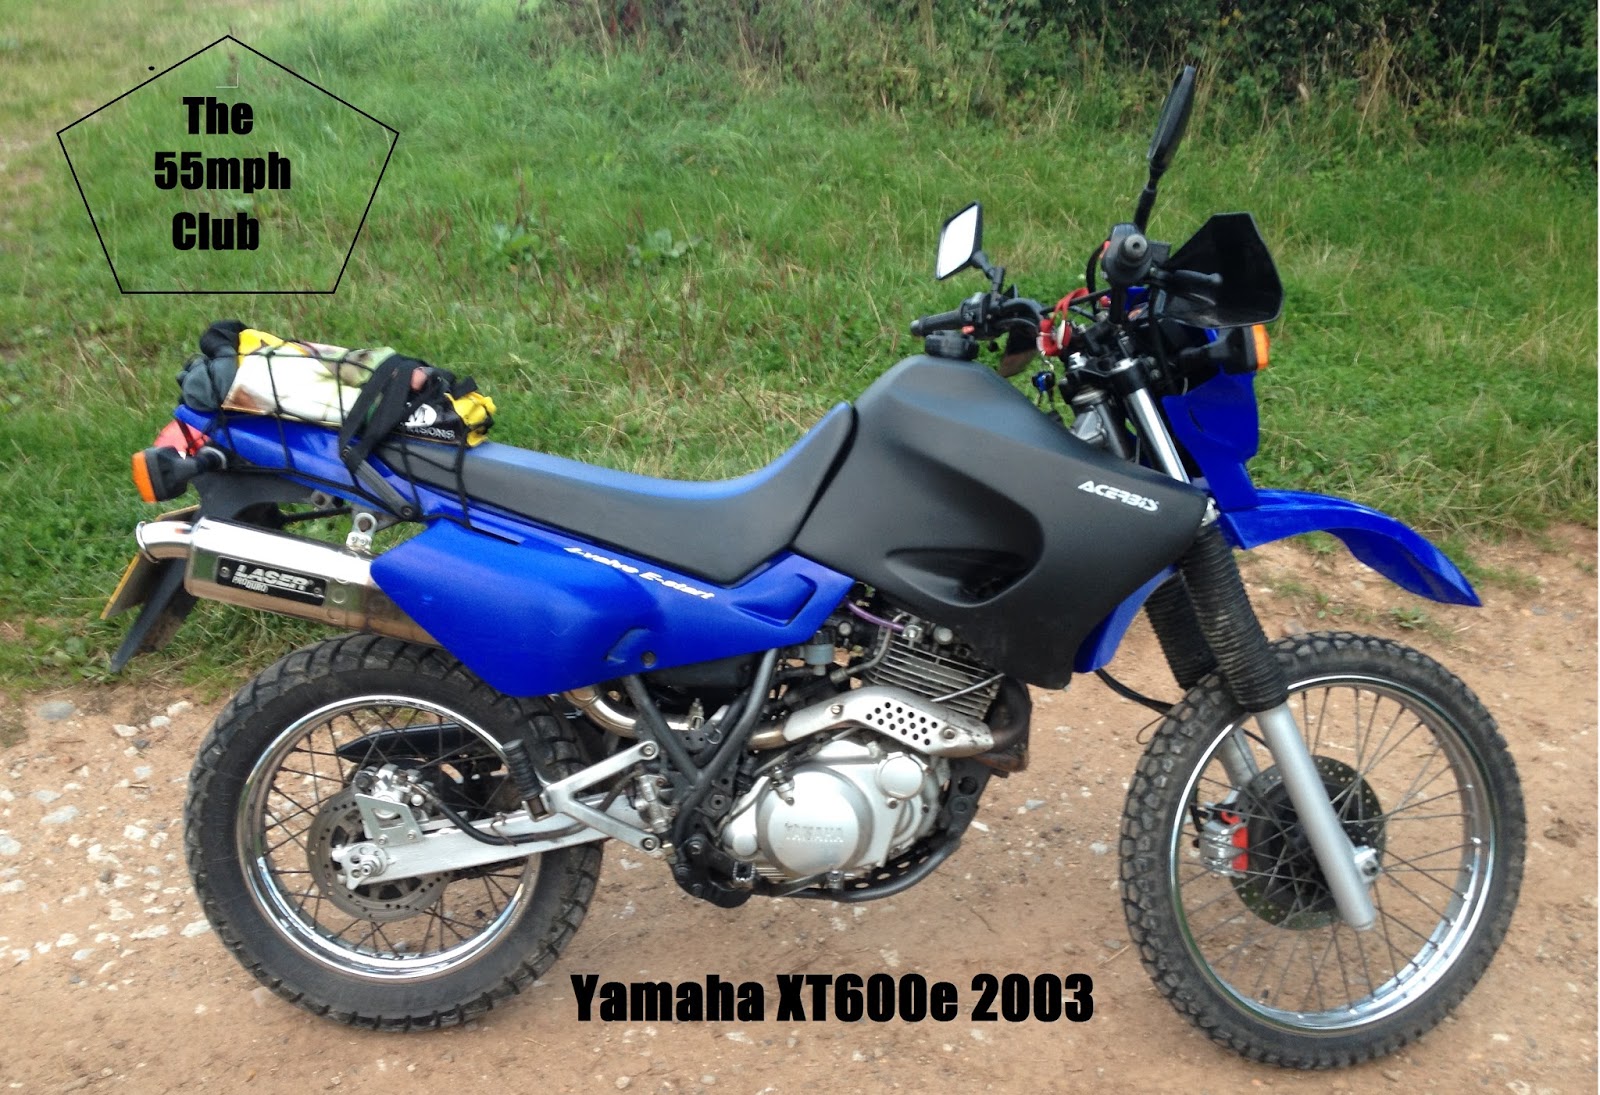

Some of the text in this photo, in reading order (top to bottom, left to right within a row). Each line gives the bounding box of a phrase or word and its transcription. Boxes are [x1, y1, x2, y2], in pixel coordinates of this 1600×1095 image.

[1077, 480, 1159, 512] ACERBIS
[233, 564, 309, 592] LASER
[638, 571, 716, 600] E-start
